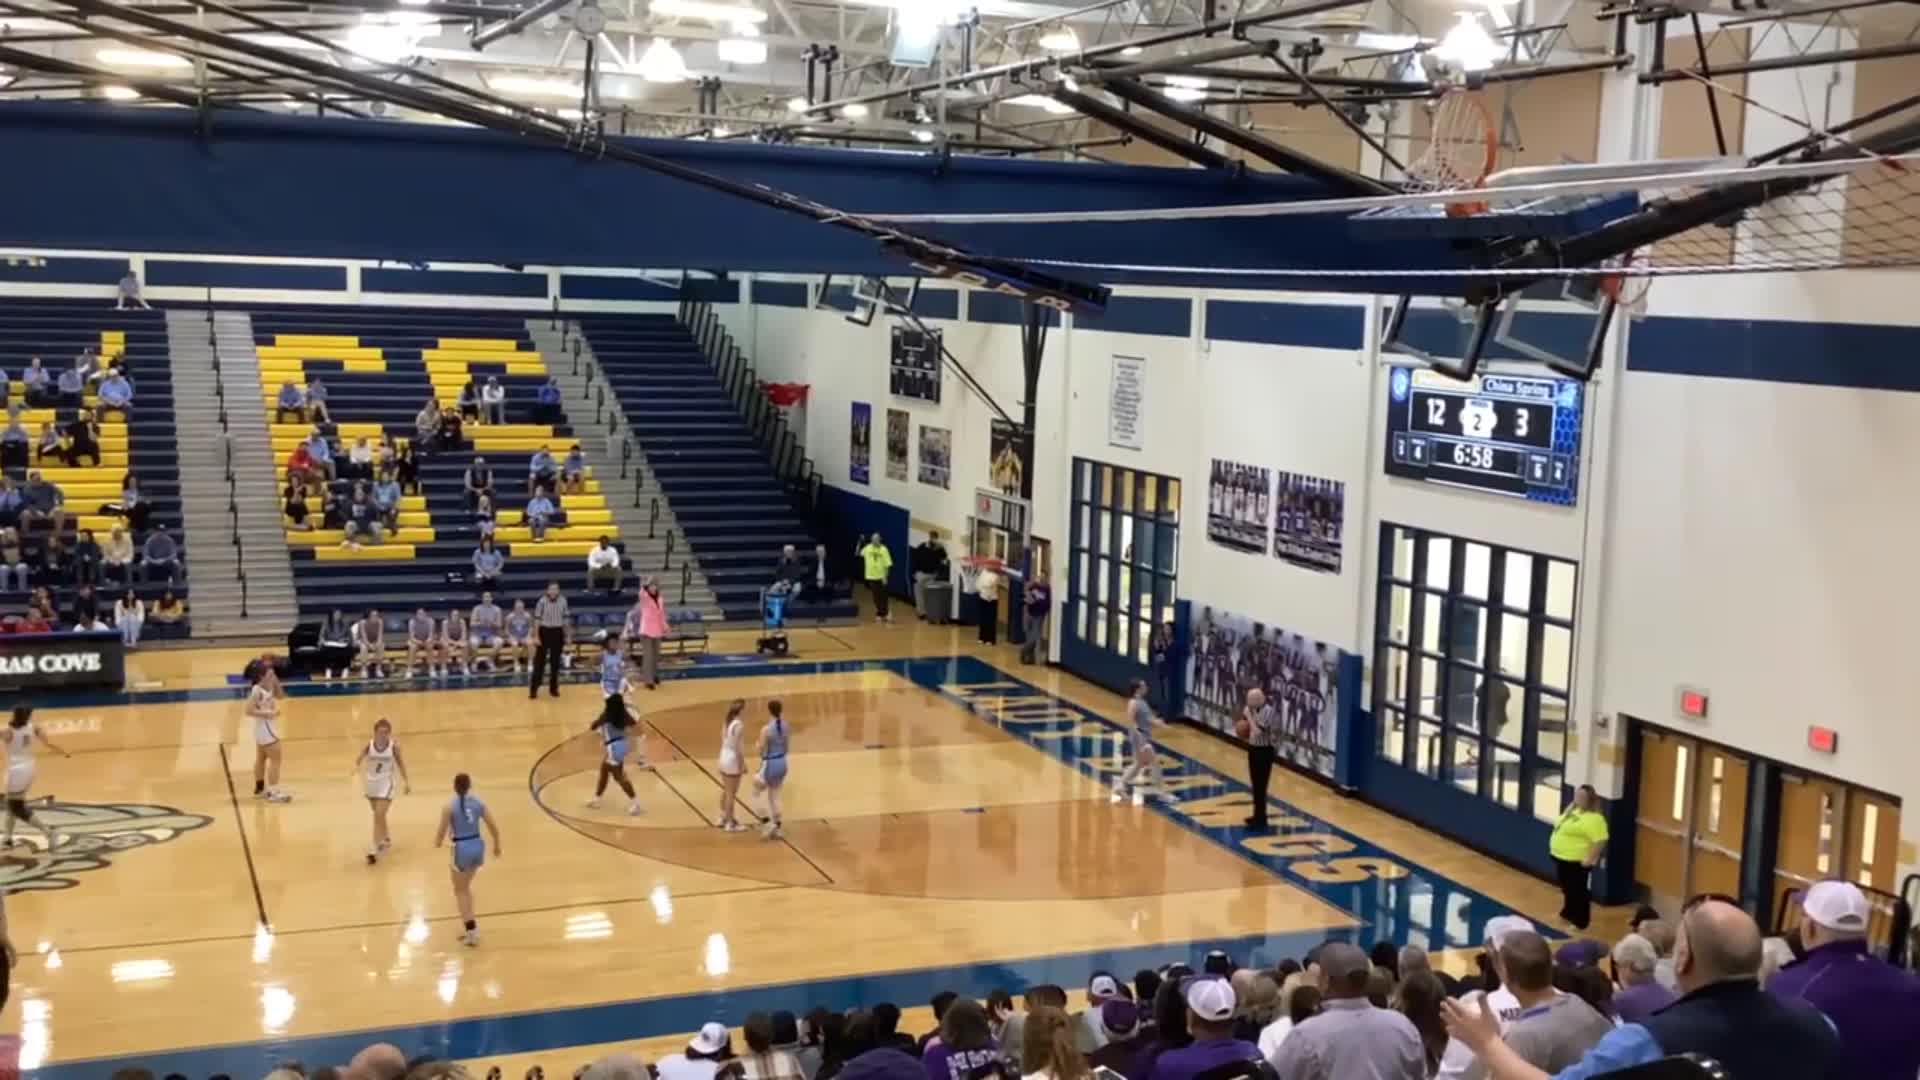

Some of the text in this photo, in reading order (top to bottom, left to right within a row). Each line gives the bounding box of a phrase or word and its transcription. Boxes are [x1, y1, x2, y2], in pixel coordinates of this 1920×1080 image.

[1486, 379, 1513, 391] China
[1516, 381, 1549, 399] Spring
[1427, 398, 1446, 425] 12
[1473, 414, 1481, 431] 2
[1515, 408, 1529, 437] 3
[1454, 445, 1493, 469] 6:58
[39, 653, 101, 673] COVE
